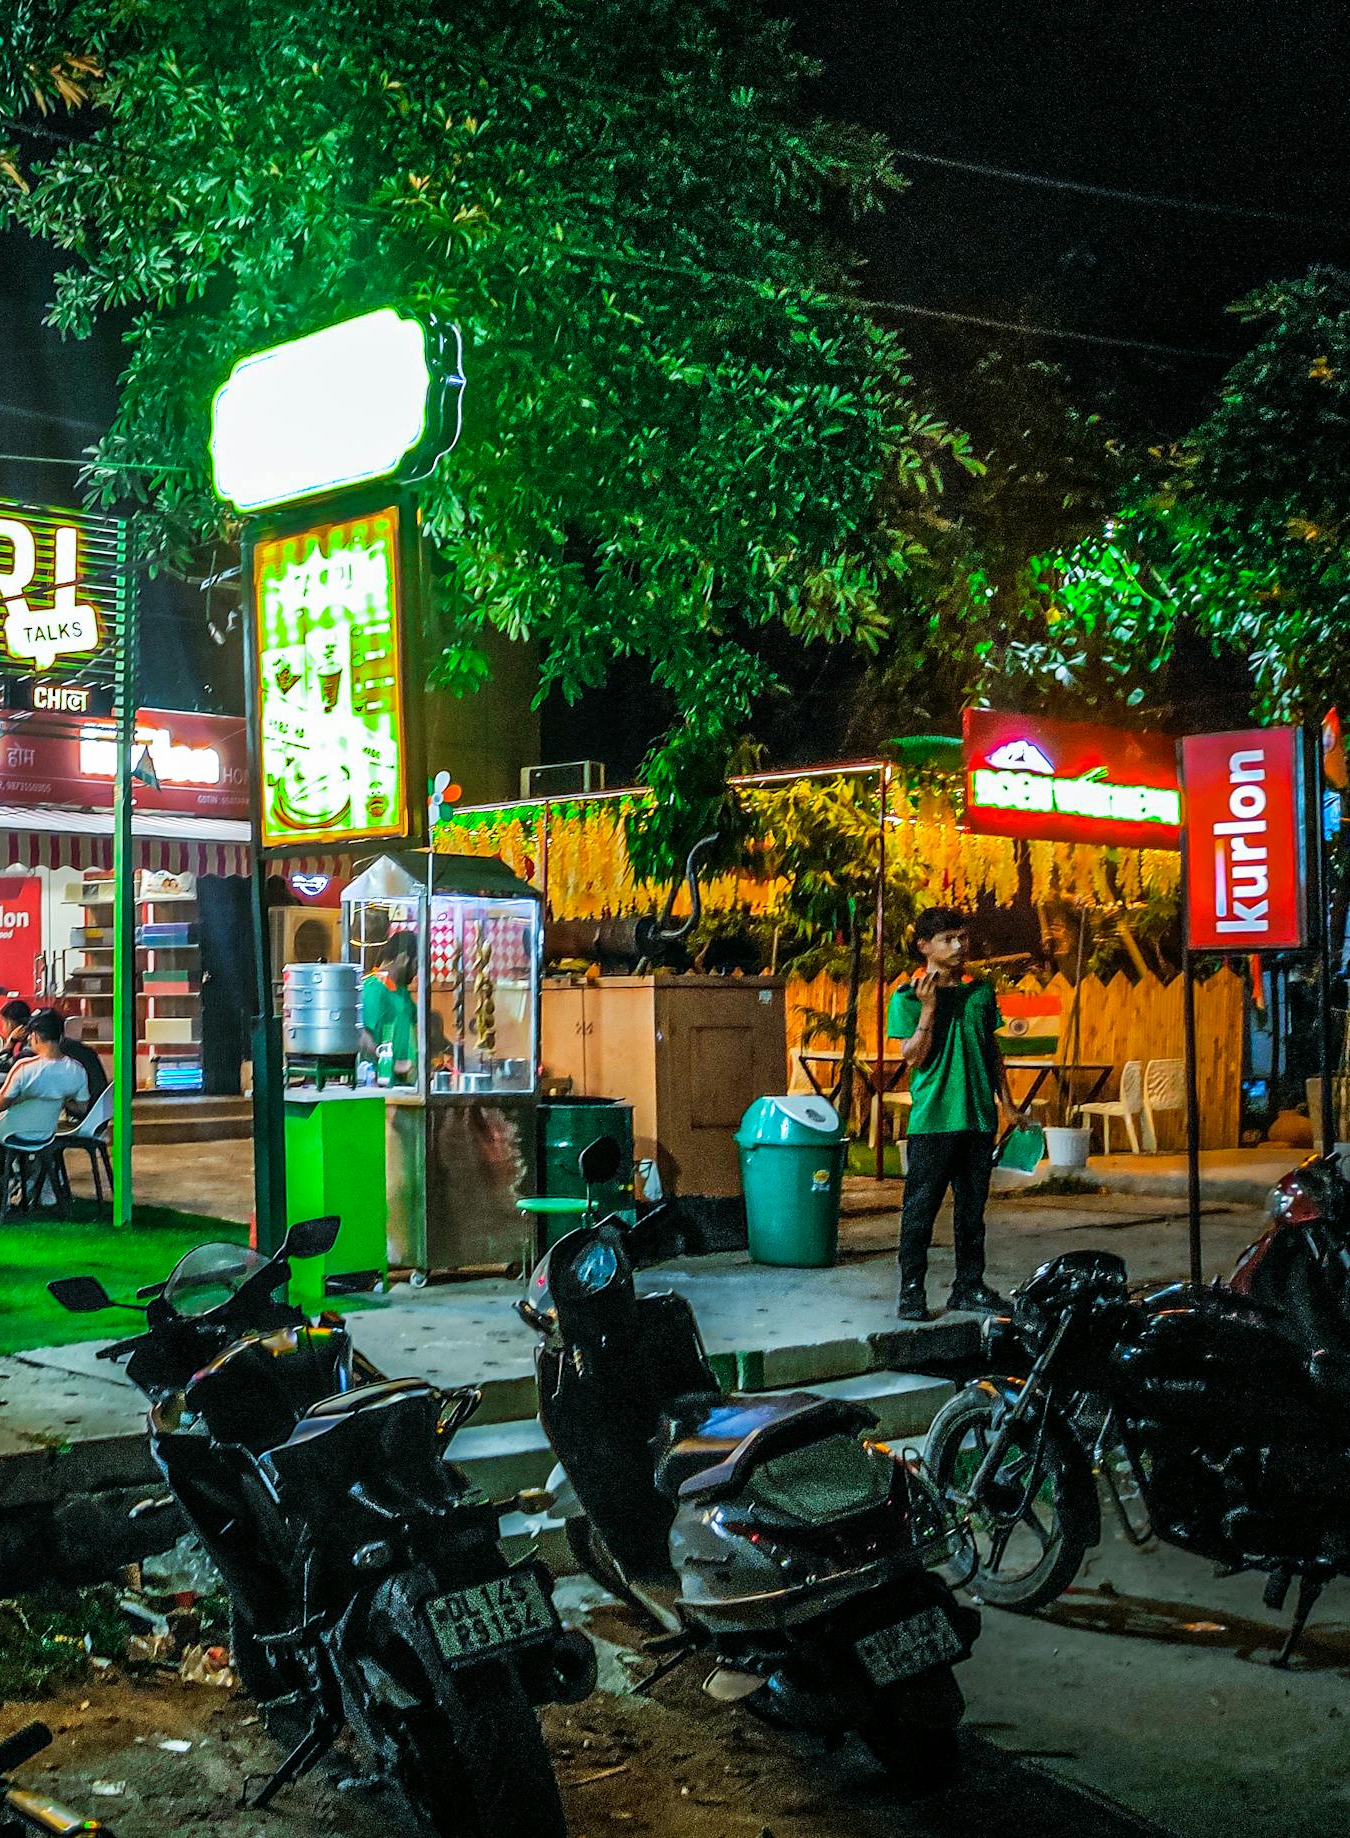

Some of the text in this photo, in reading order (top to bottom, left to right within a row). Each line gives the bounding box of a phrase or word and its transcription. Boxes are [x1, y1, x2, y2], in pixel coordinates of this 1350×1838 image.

[23, 621, 83, 643] TALKS
[6, 742, 36, 767] होम
[223, 767, 250, 785] HO
[1213, 749, 1269, 933] kurlon
